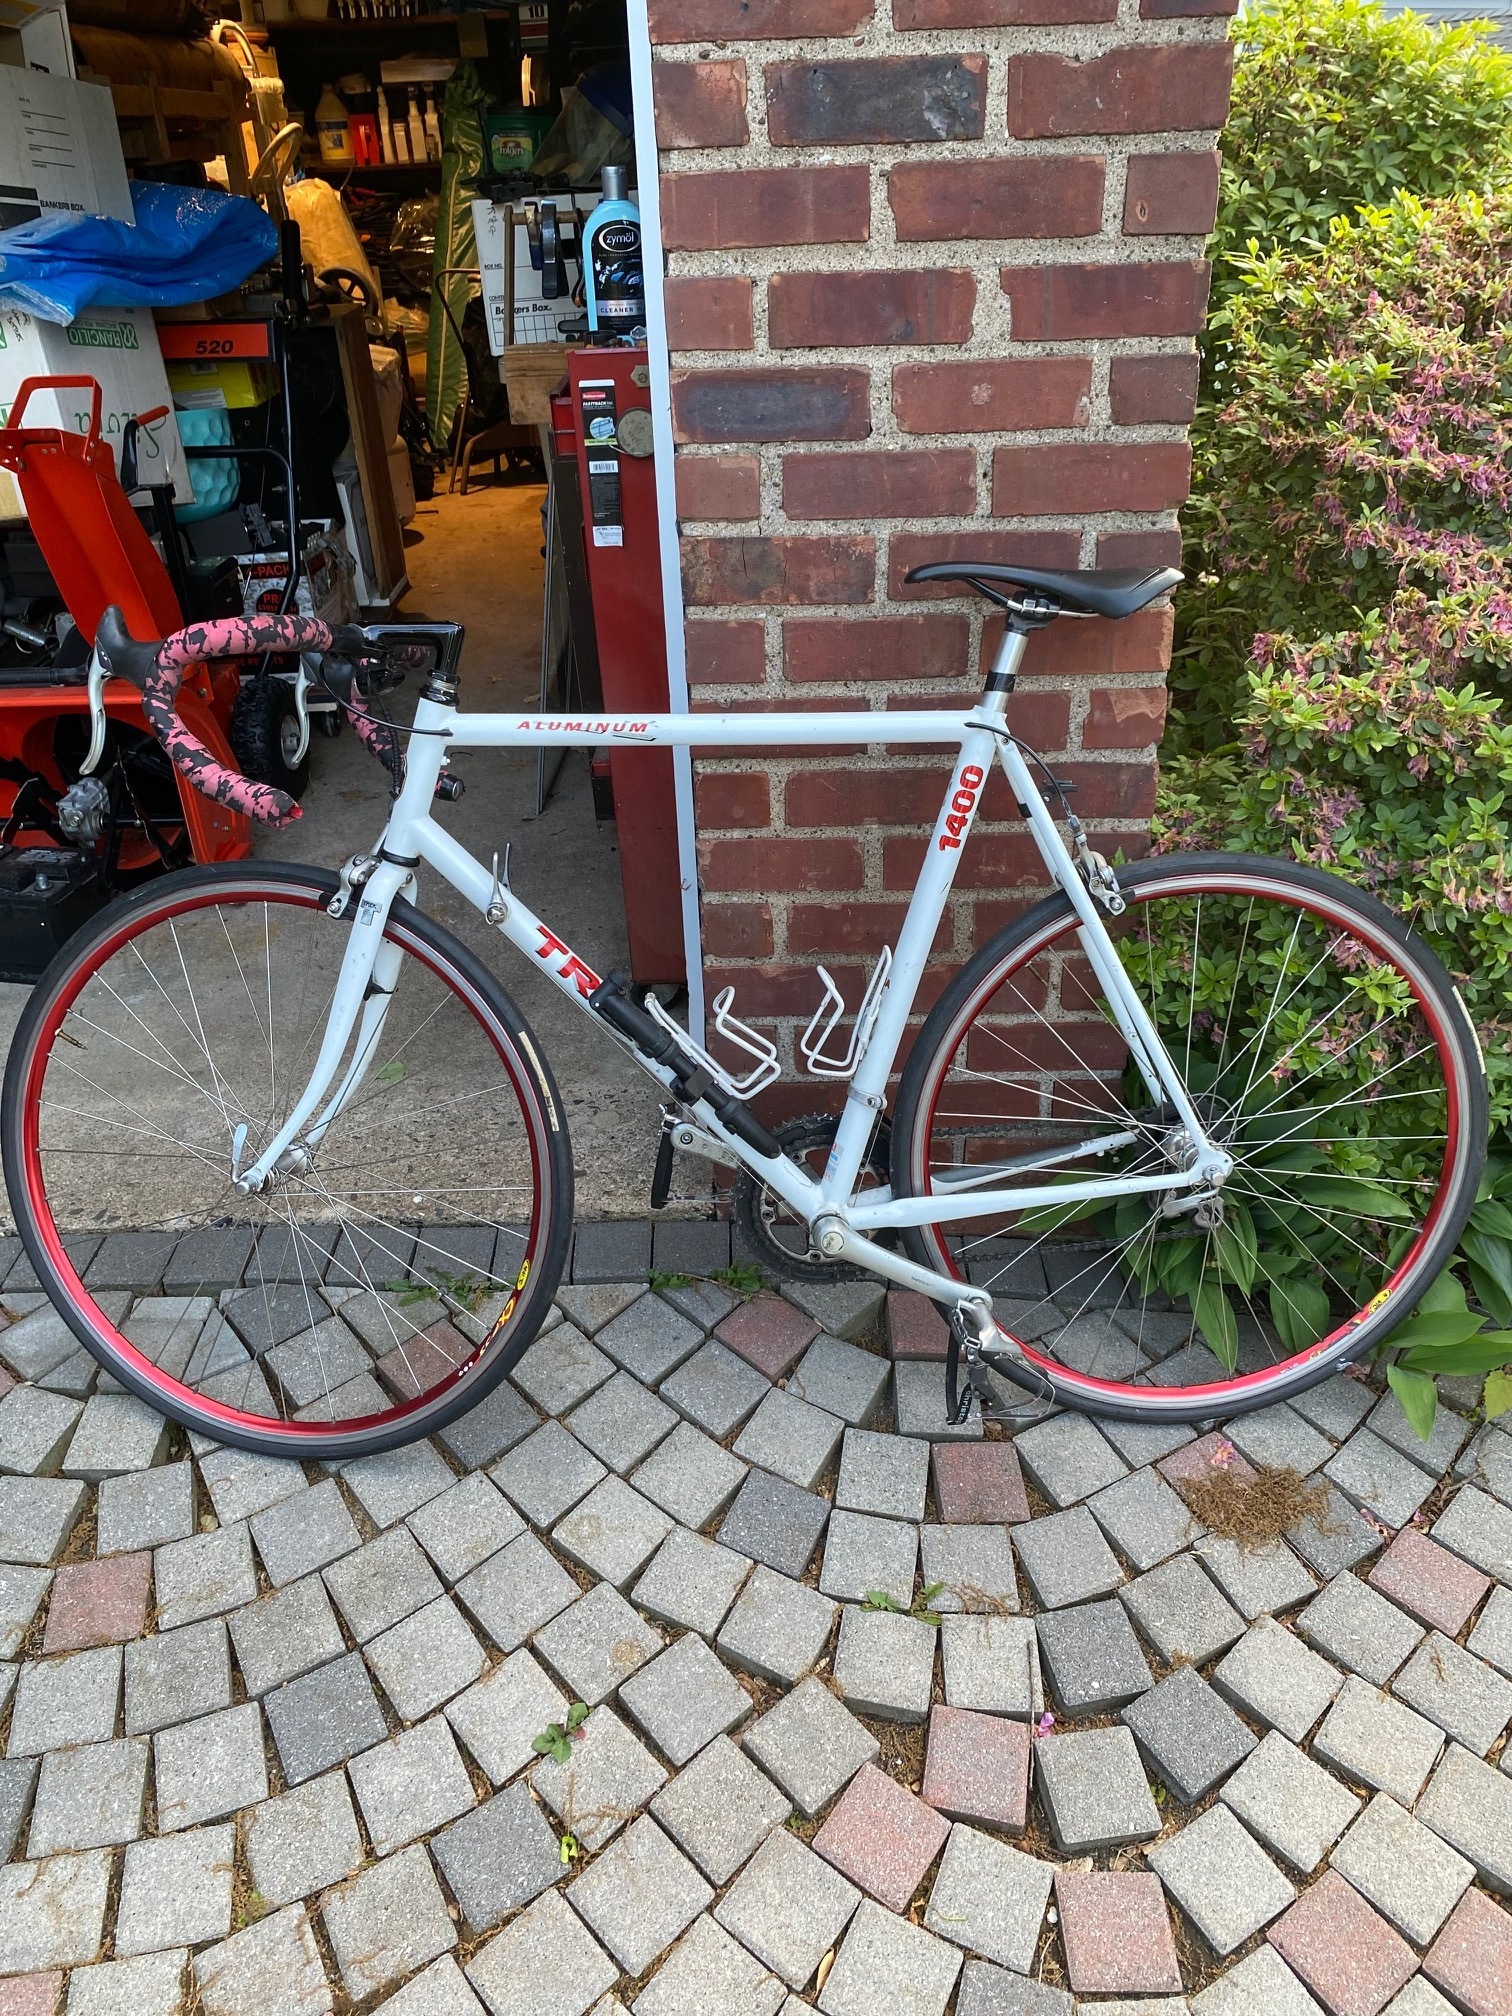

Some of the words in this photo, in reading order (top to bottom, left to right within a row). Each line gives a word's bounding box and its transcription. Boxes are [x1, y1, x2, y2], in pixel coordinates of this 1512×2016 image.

[606, 232, 634, 246] zymöl
[495, 306, 530, 315] Bkers
[69, 328, 121, 347] RANCILIO
[195, 340, 234, 354] 520
[263, 593, 279, 604] PR
[258, 604, 297, 613] STREH
[516, 721, 649, 732] ALUMINUM
[939, 765, 984, 851] 1400
[535, 925, 601, 1000] TR
